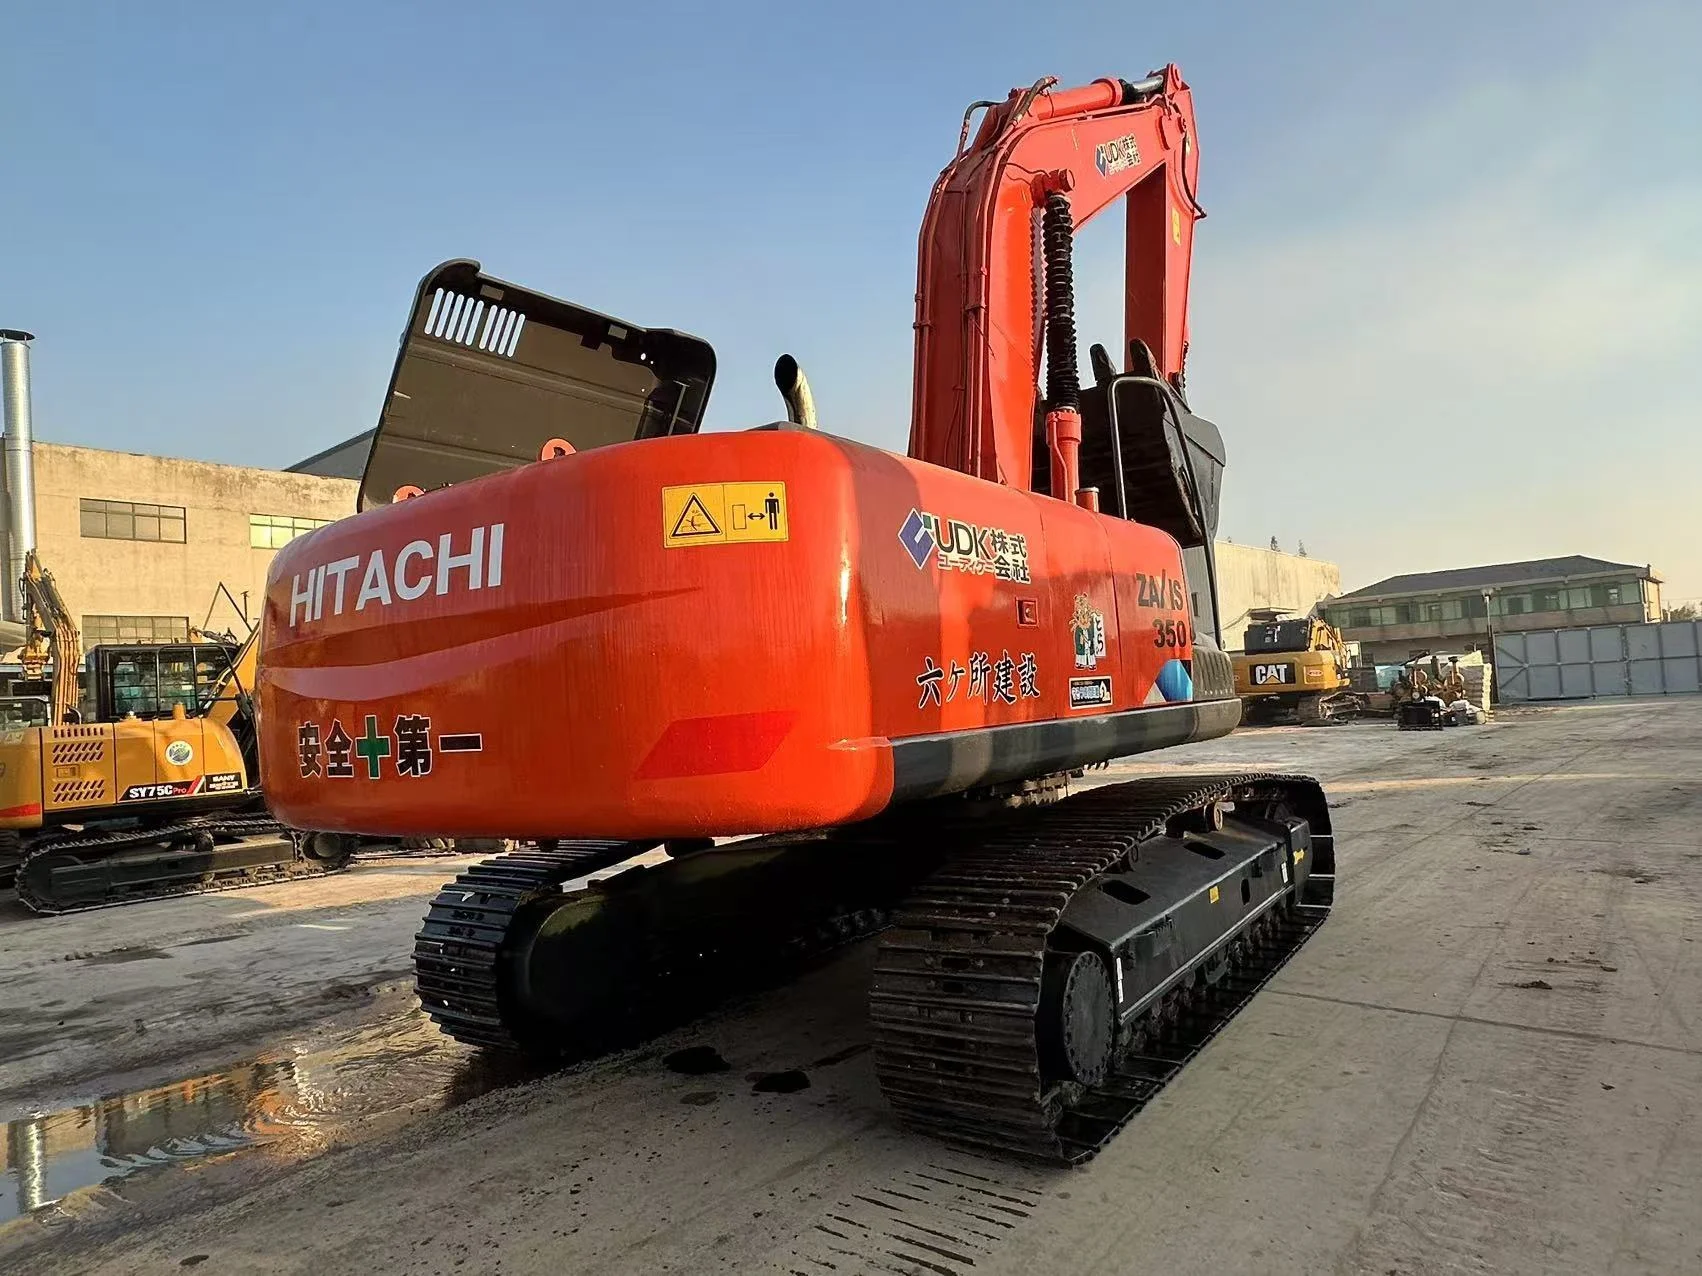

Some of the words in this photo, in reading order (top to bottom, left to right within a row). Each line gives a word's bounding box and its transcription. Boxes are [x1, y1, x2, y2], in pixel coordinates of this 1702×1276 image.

[934, 517, 993, 560] UDK
[990, 528, 1027, 558] 株式
[289, 523, 504, 628] HITACHI
[994, 554, 1030, 582] 会社
[1152, 618, 1187, 648] 350
[1255, 664, 1288, 685] CAT
[129, 784, 173, 798] SY75C
